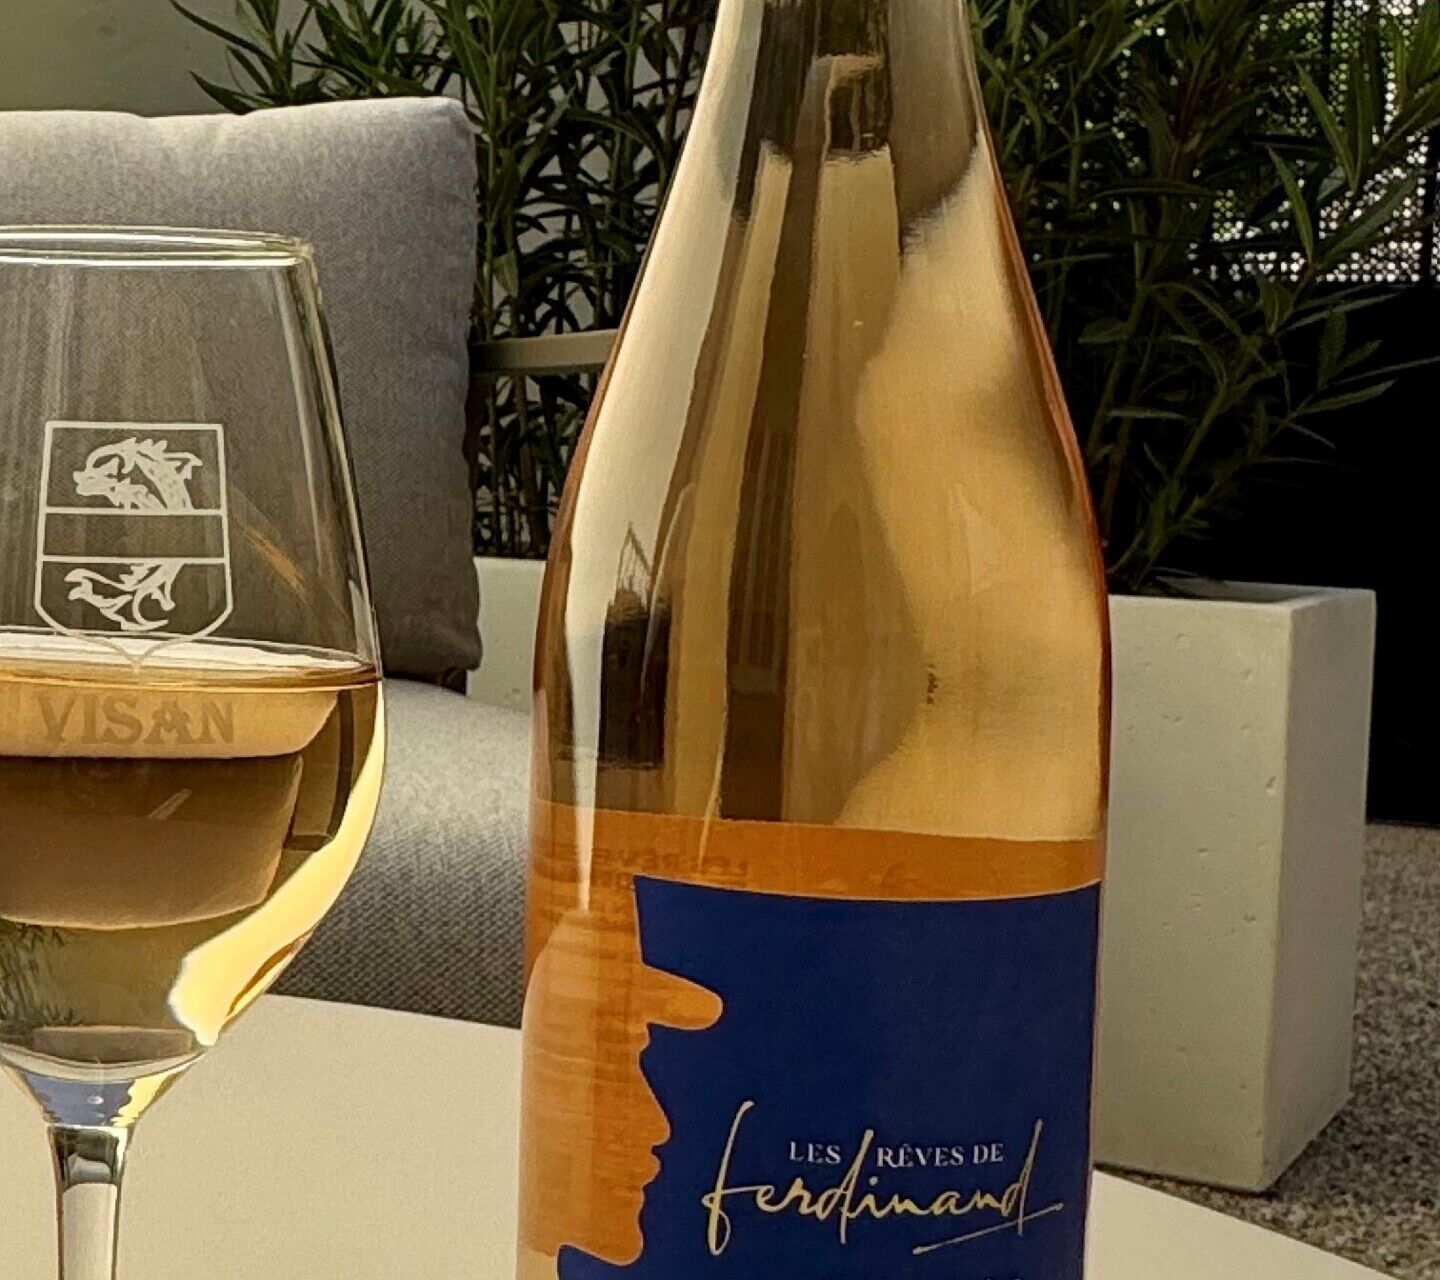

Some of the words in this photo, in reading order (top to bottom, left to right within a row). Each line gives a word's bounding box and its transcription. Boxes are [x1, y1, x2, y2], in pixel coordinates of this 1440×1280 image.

[35, 692, 235, 746] VISAN
[789, 1141, 842, 1165] LES
[876, 1141, 964, 1168] RÊVES
[972, 1142, 1005, 1164] DE
